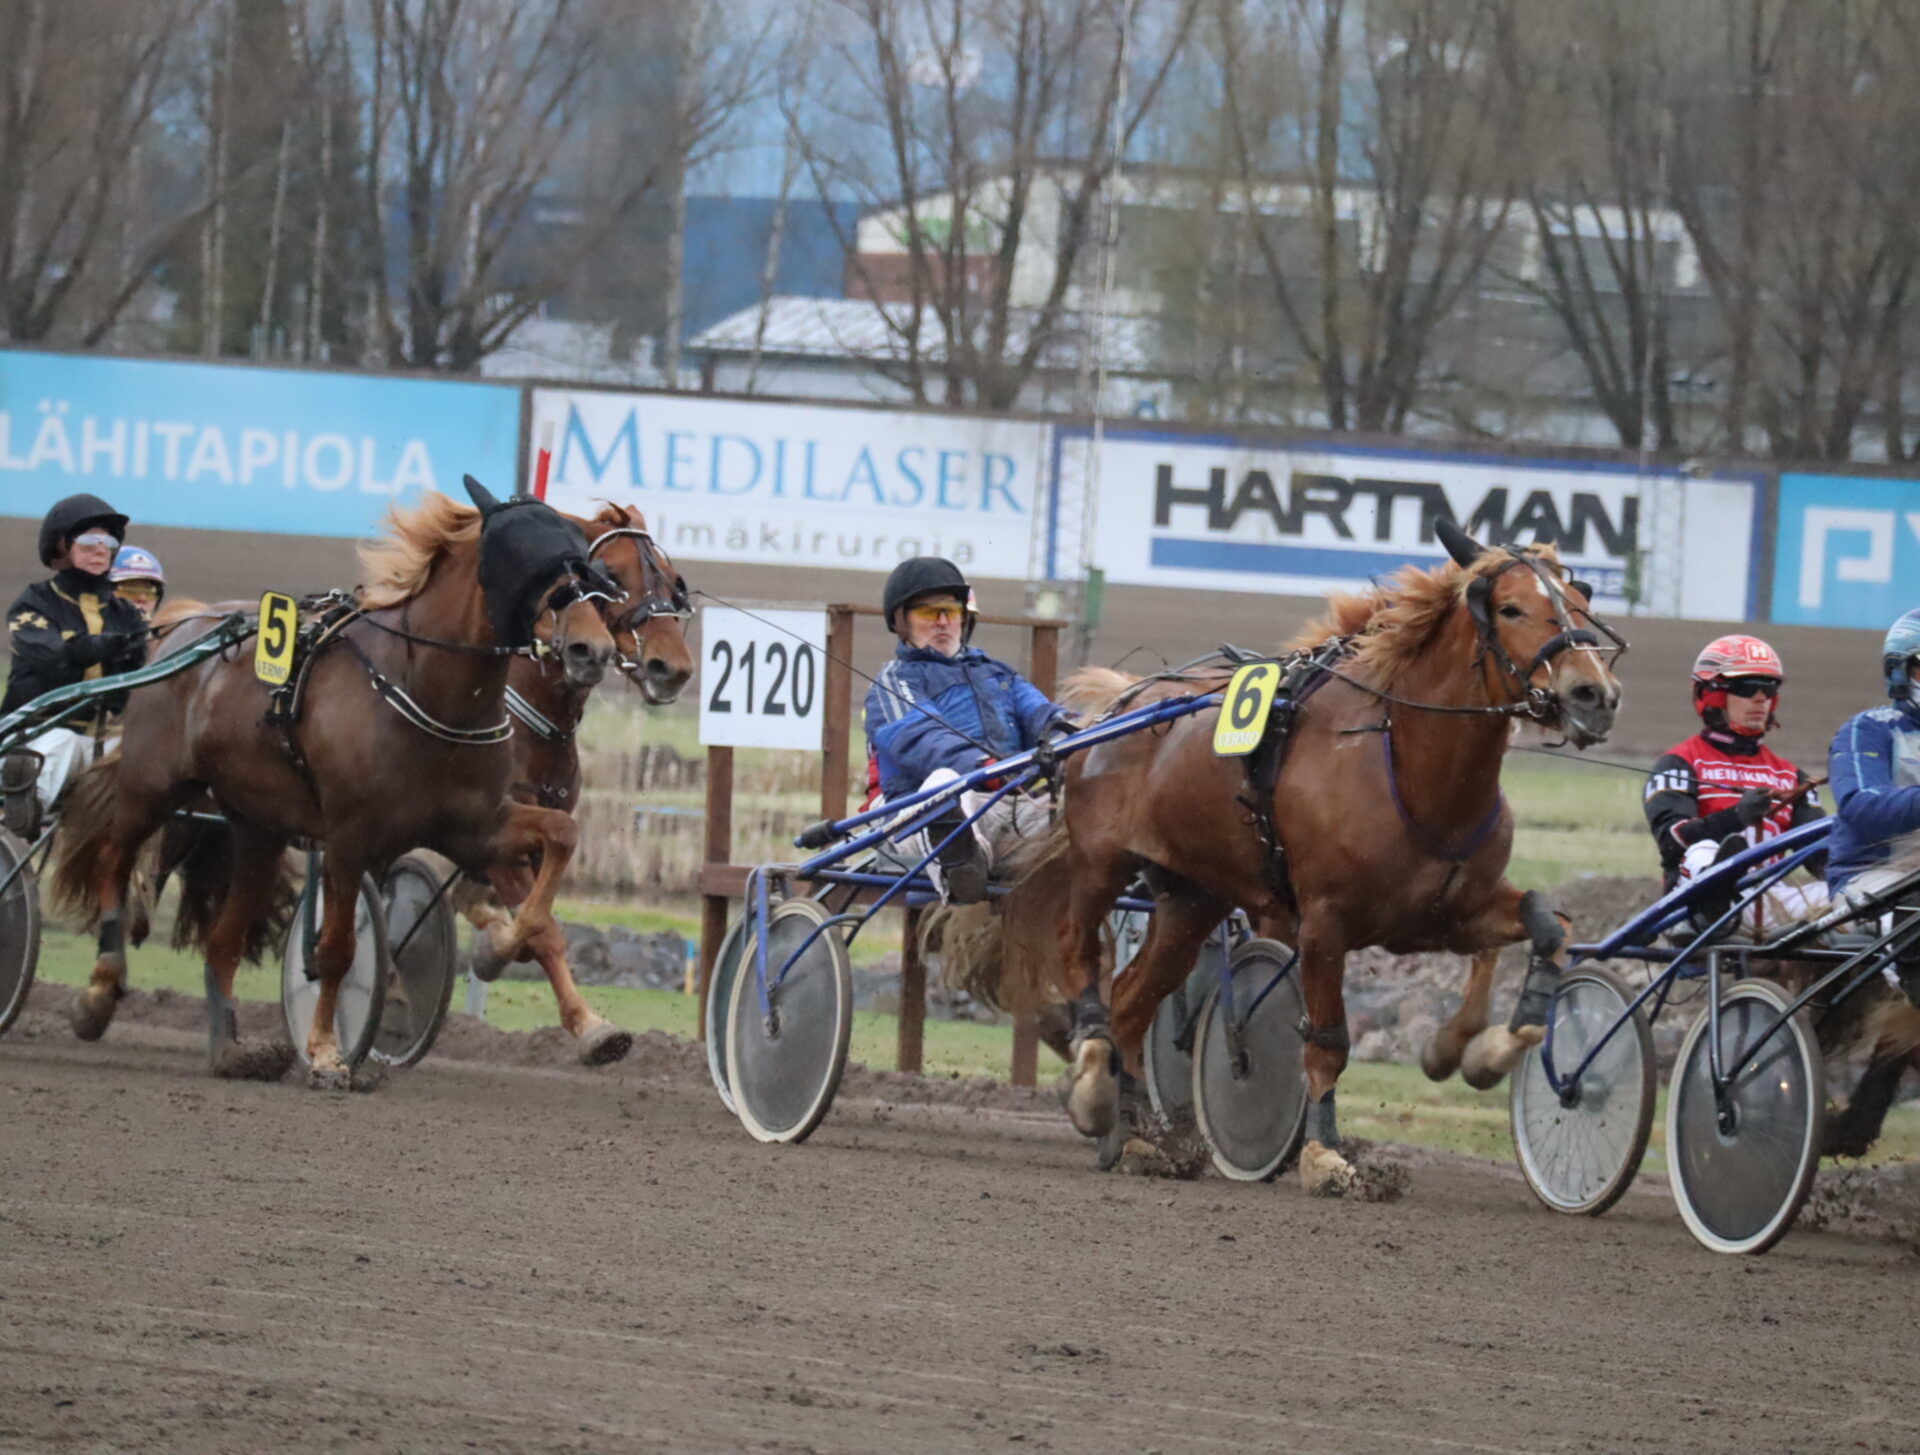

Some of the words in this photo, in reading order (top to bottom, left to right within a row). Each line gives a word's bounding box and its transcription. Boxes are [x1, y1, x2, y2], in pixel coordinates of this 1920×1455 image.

[0, 399, 438, 494] LÄHITAPIOLA
[656, 510, 976, 564] lmäkirurgia
[1155, 464, 1639, 556] HARTMAN
[1799, 507, 1920, 608] P
[264, 596, 289, 659] 5
[708, 640, 815, 718] 2120
[1231, 666, 1268, 730] 6
